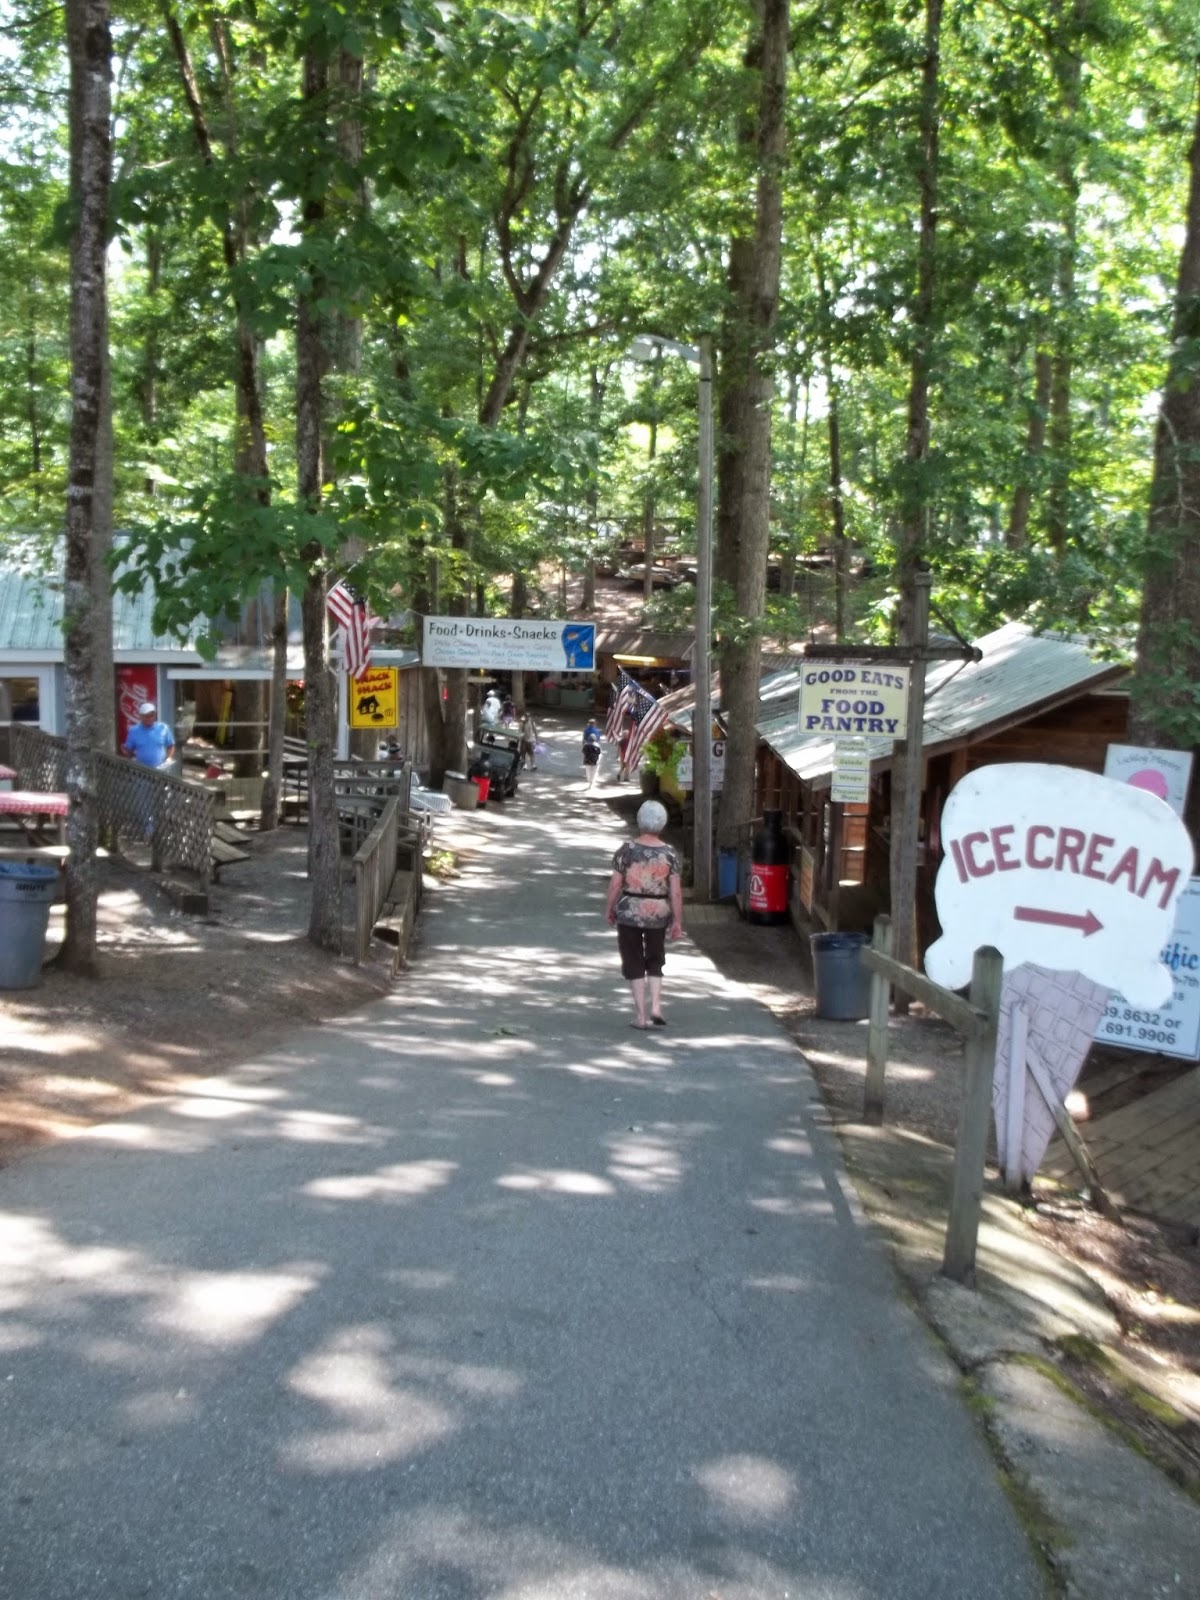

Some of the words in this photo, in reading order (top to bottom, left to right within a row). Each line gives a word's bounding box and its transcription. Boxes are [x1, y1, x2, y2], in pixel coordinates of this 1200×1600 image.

[805, 670, 856, 686] GOOD
[861, 671, 904, 690] EATS
[821, 699, 885, 715] FOOD
[806, 715, 899, 734] PANTRY
[950, 824, 1021, 883] ICE
[1025, 825, 1182, 910] CREAM
[1102, 1006, 1160, 1026] 39.8632
[1164, 1018, 1182, 1029] or
[1101, 1022, 1176, 1044] .691.9906
